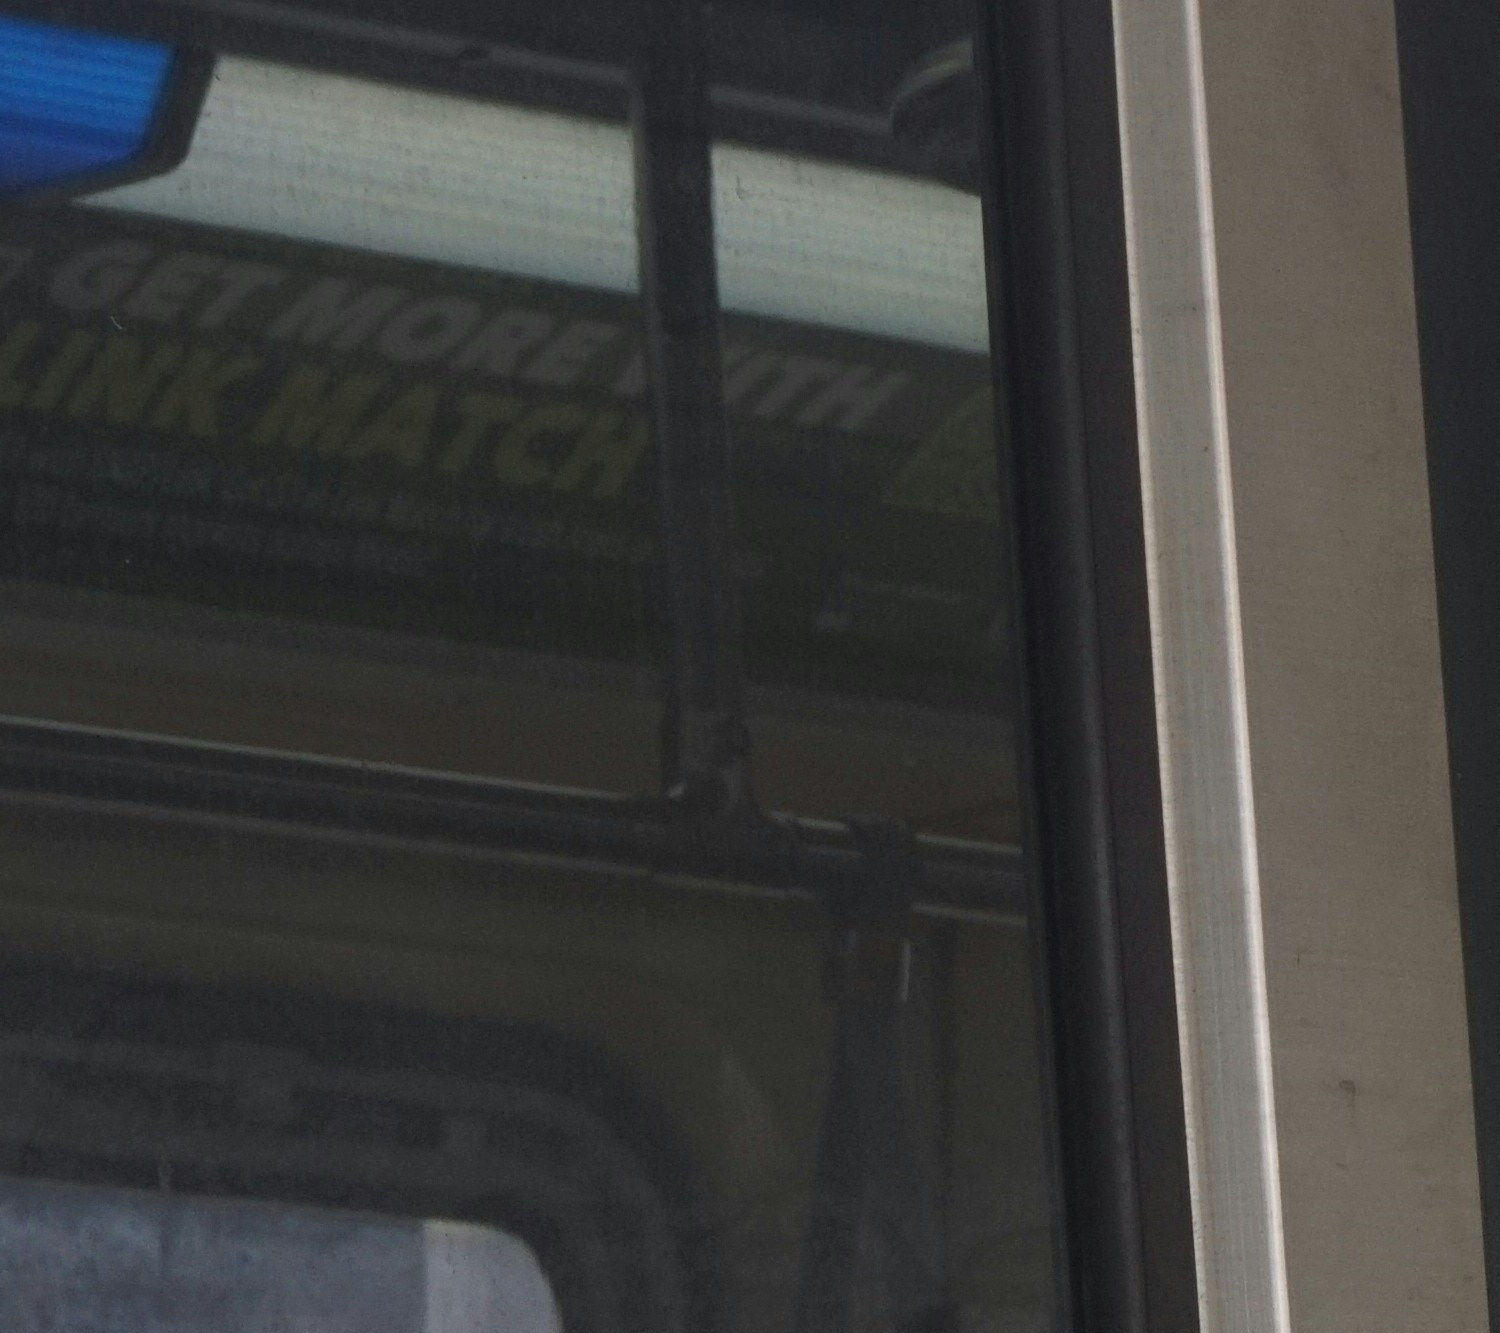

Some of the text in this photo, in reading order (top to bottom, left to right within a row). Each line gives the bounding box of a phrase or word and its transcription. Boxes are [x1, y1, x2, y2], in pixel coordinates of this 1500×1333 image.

[49, 240, 289, 327] GET
[266, 276, 621, 384] MORE
[250, 366, 649, 498] MATCH
